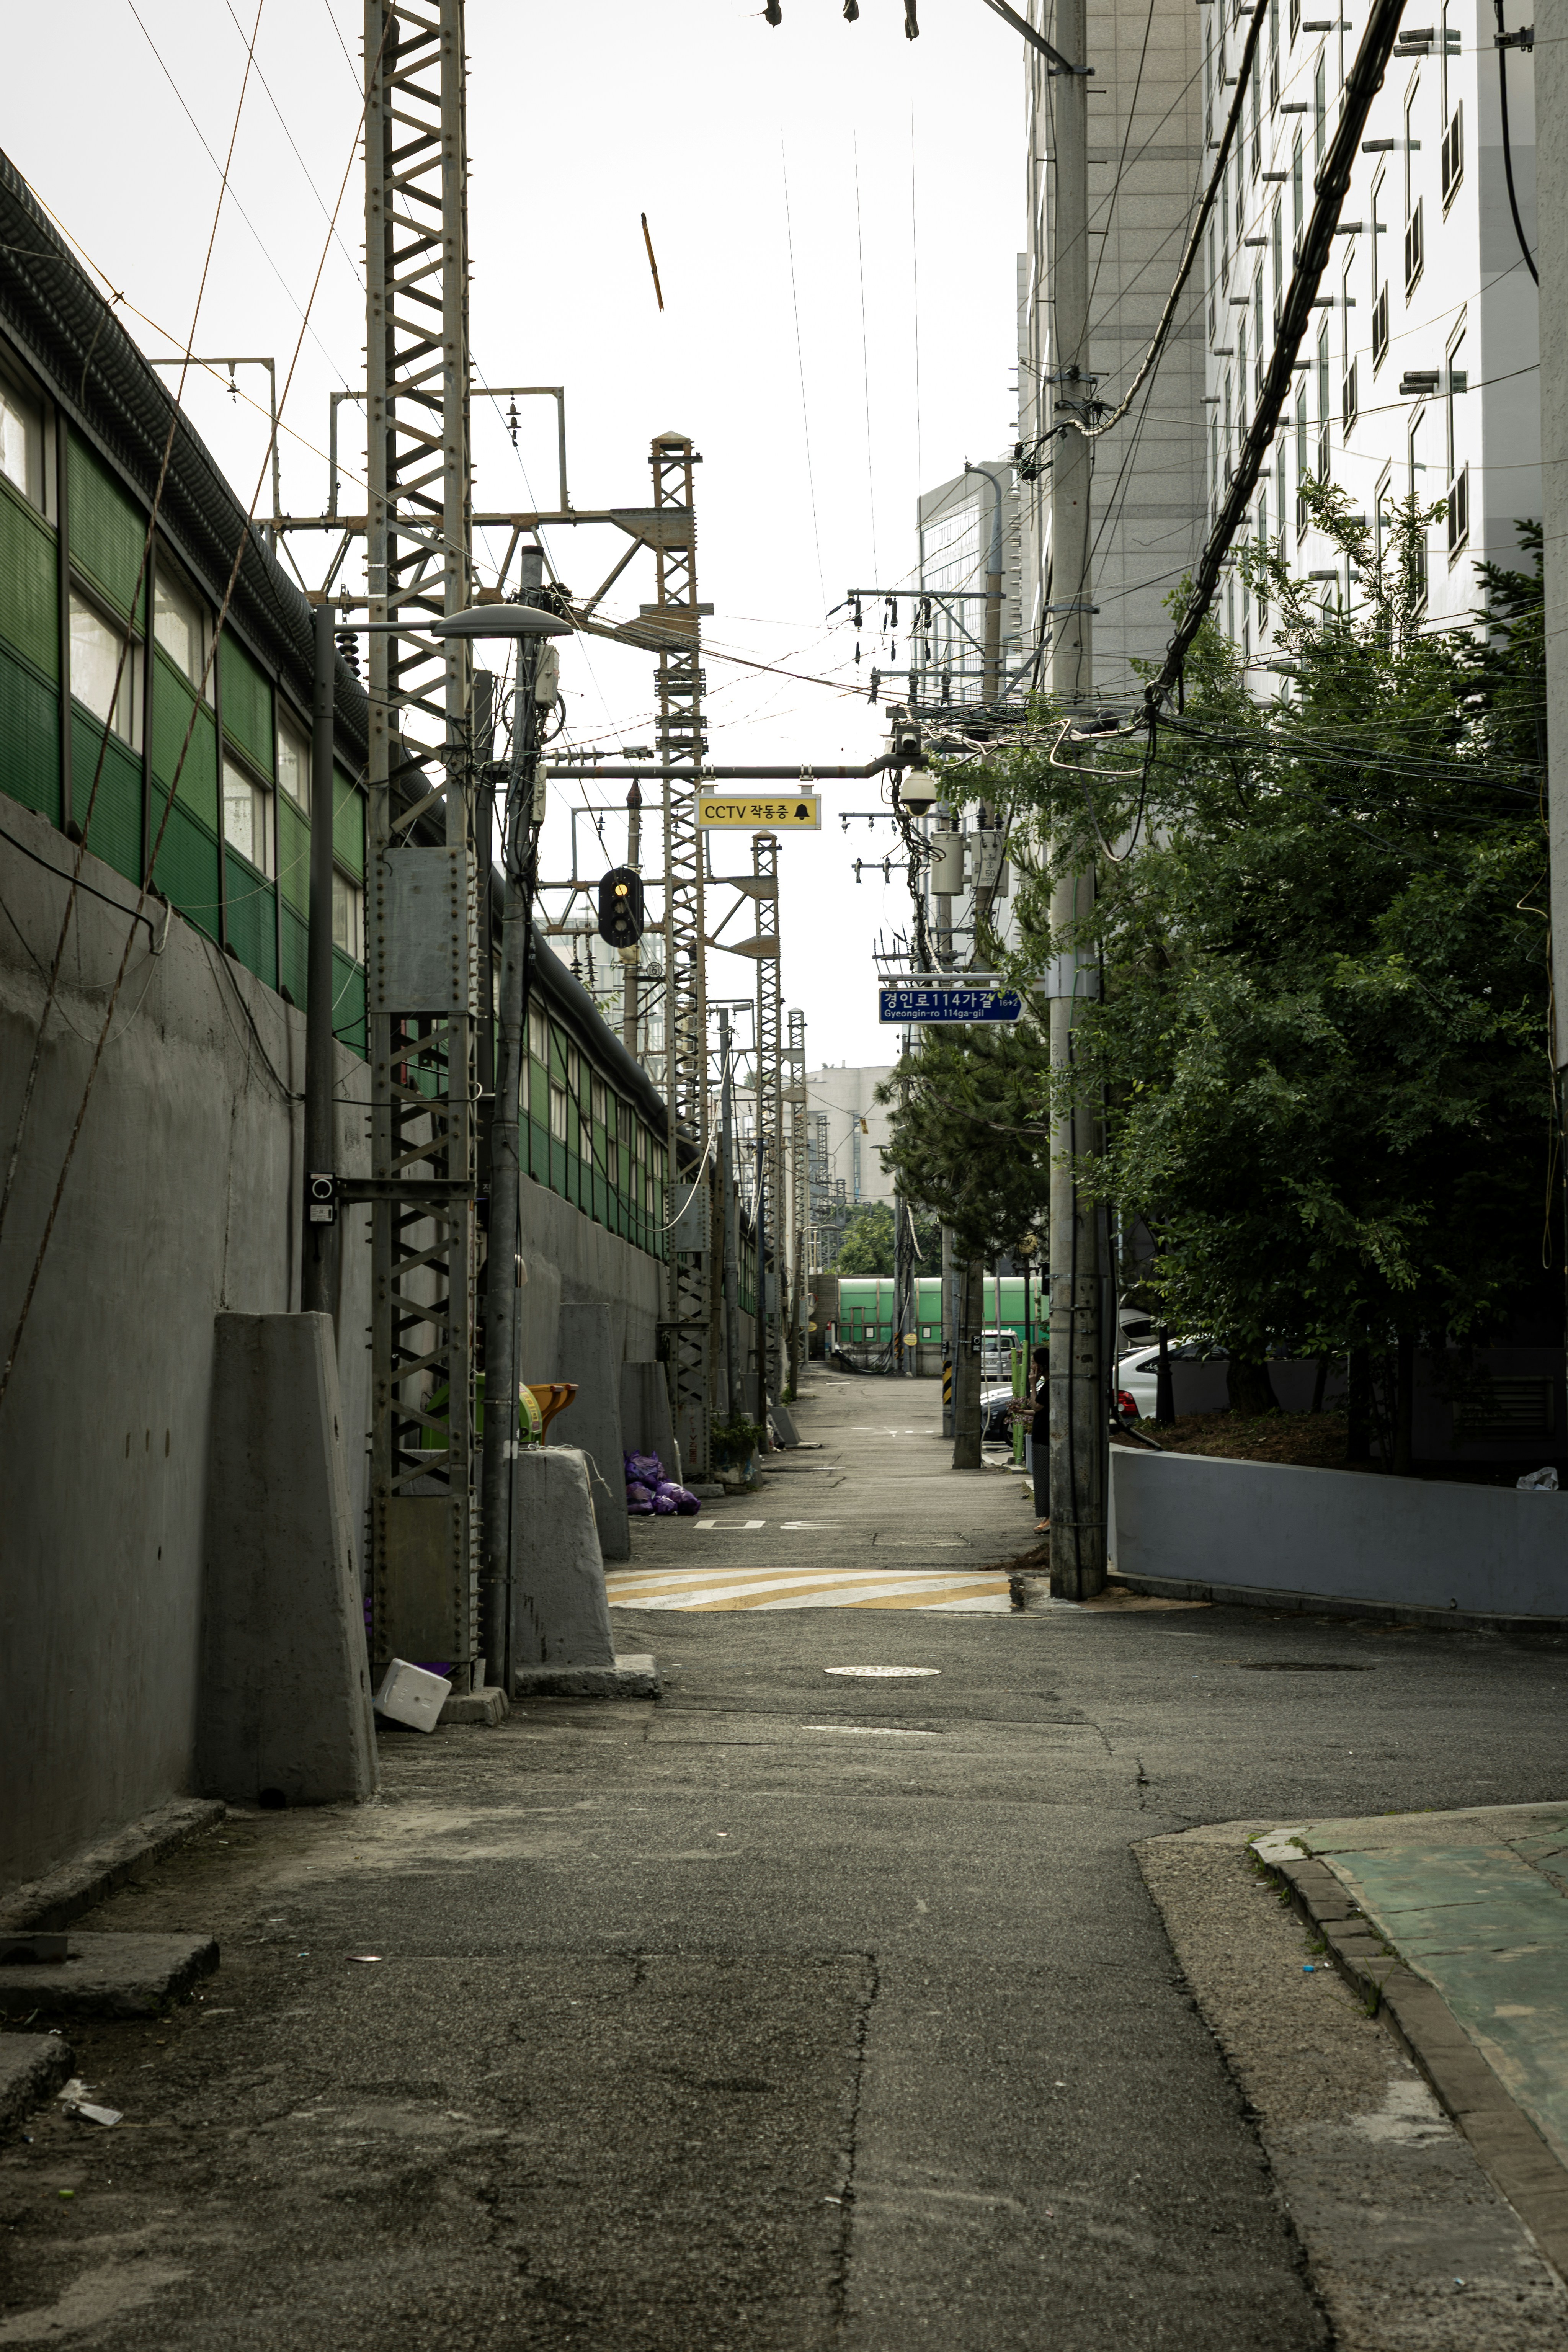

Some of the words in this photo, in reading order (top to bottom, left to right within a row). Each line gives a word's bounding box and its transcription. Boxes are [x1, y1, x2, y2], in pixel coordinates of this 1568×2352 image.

[705, 805, 746, 818] CCTV
[750, 805, 789, 819] 작동중
[884, 992, 992, 1008] 경인로114가길
[884, 1009, 940, 1018] Gyeongin-ro
[943, 1009, 984, 1018] 114ga-gil
